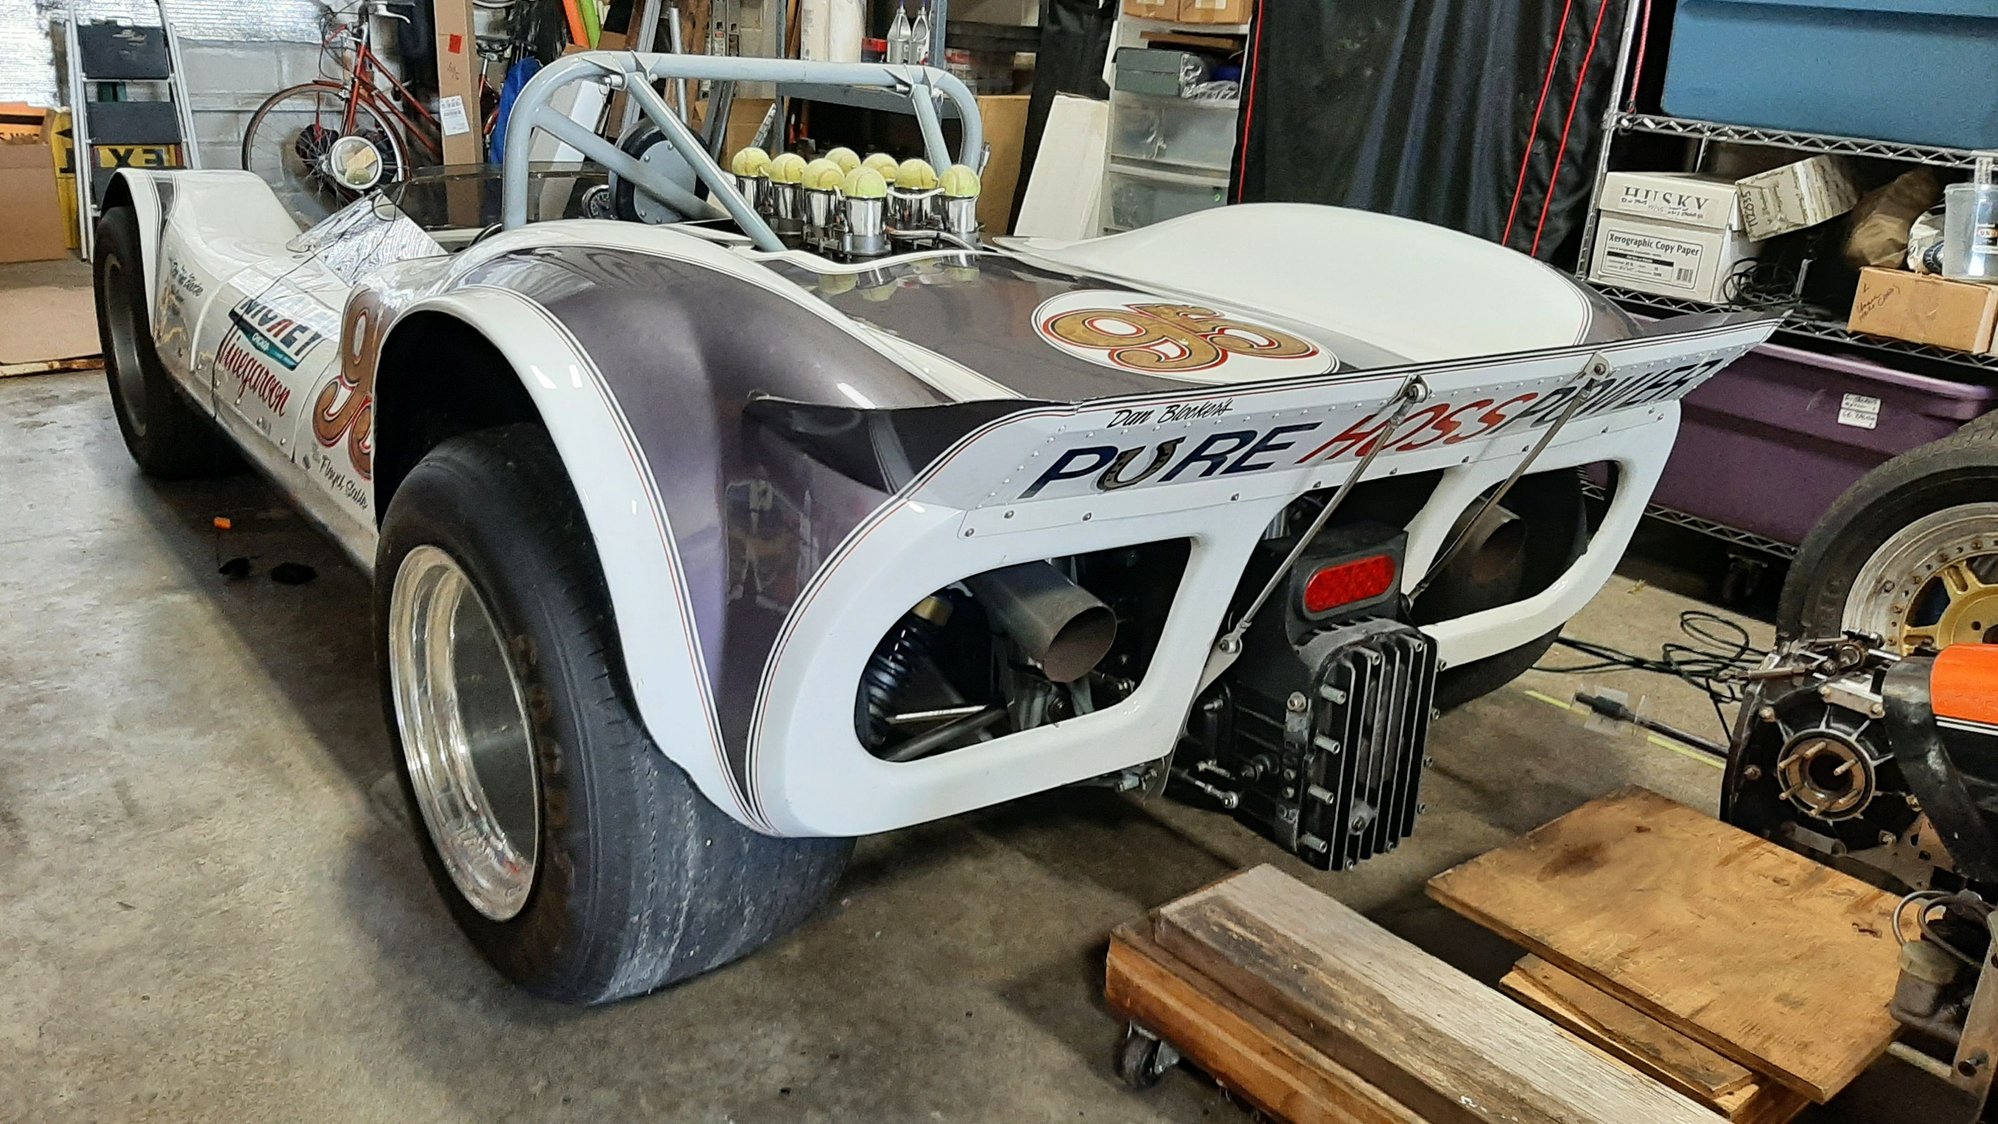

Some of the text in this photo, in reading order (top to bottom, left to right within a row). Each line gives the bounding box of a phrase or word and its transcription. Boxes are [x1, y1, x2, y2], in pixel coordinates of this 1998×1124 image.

[1624, 186, 1709, 210] HUSKY
[1608, 232, 1654, 249] Xerographic
[1655, 241, 1675, 254] Copy
[1676, 245, 1700, 257] Paper
[1106, 409, 1156, 429] Dan
[1017, 421, 1323, 500] PURE
